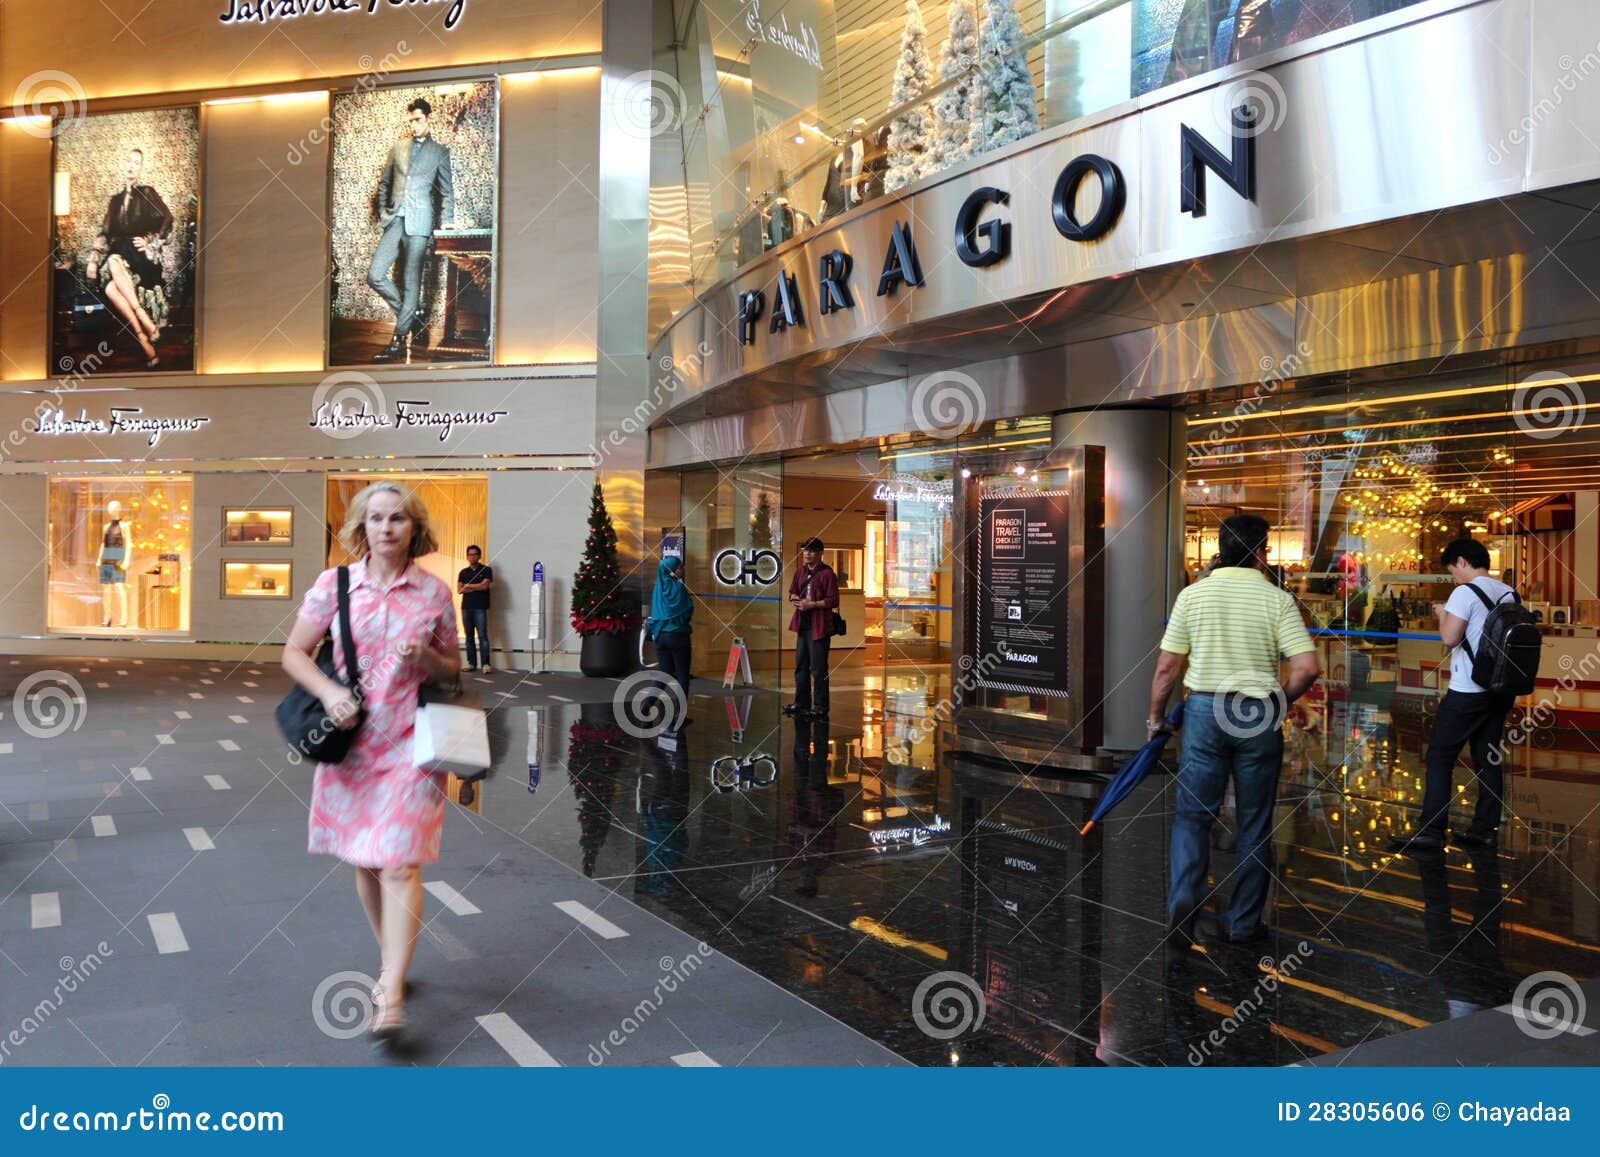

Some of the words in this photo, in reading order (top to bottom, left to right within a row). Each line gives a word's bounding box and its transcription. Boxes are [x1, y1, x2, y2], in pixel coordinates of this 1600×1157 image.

[738, 103, 1257, 346] PARAGON
[34, 409, 106, 434] Salvatore
[110, 407, 209, 446] Ferragamo
[310, 402, 389, 428] Salvatore
[395, 401, 507, 441] Ferragamo
[996, 527, 1021, 536] TRAVEL
[1006, 652, 1038, 663] PARAGON
